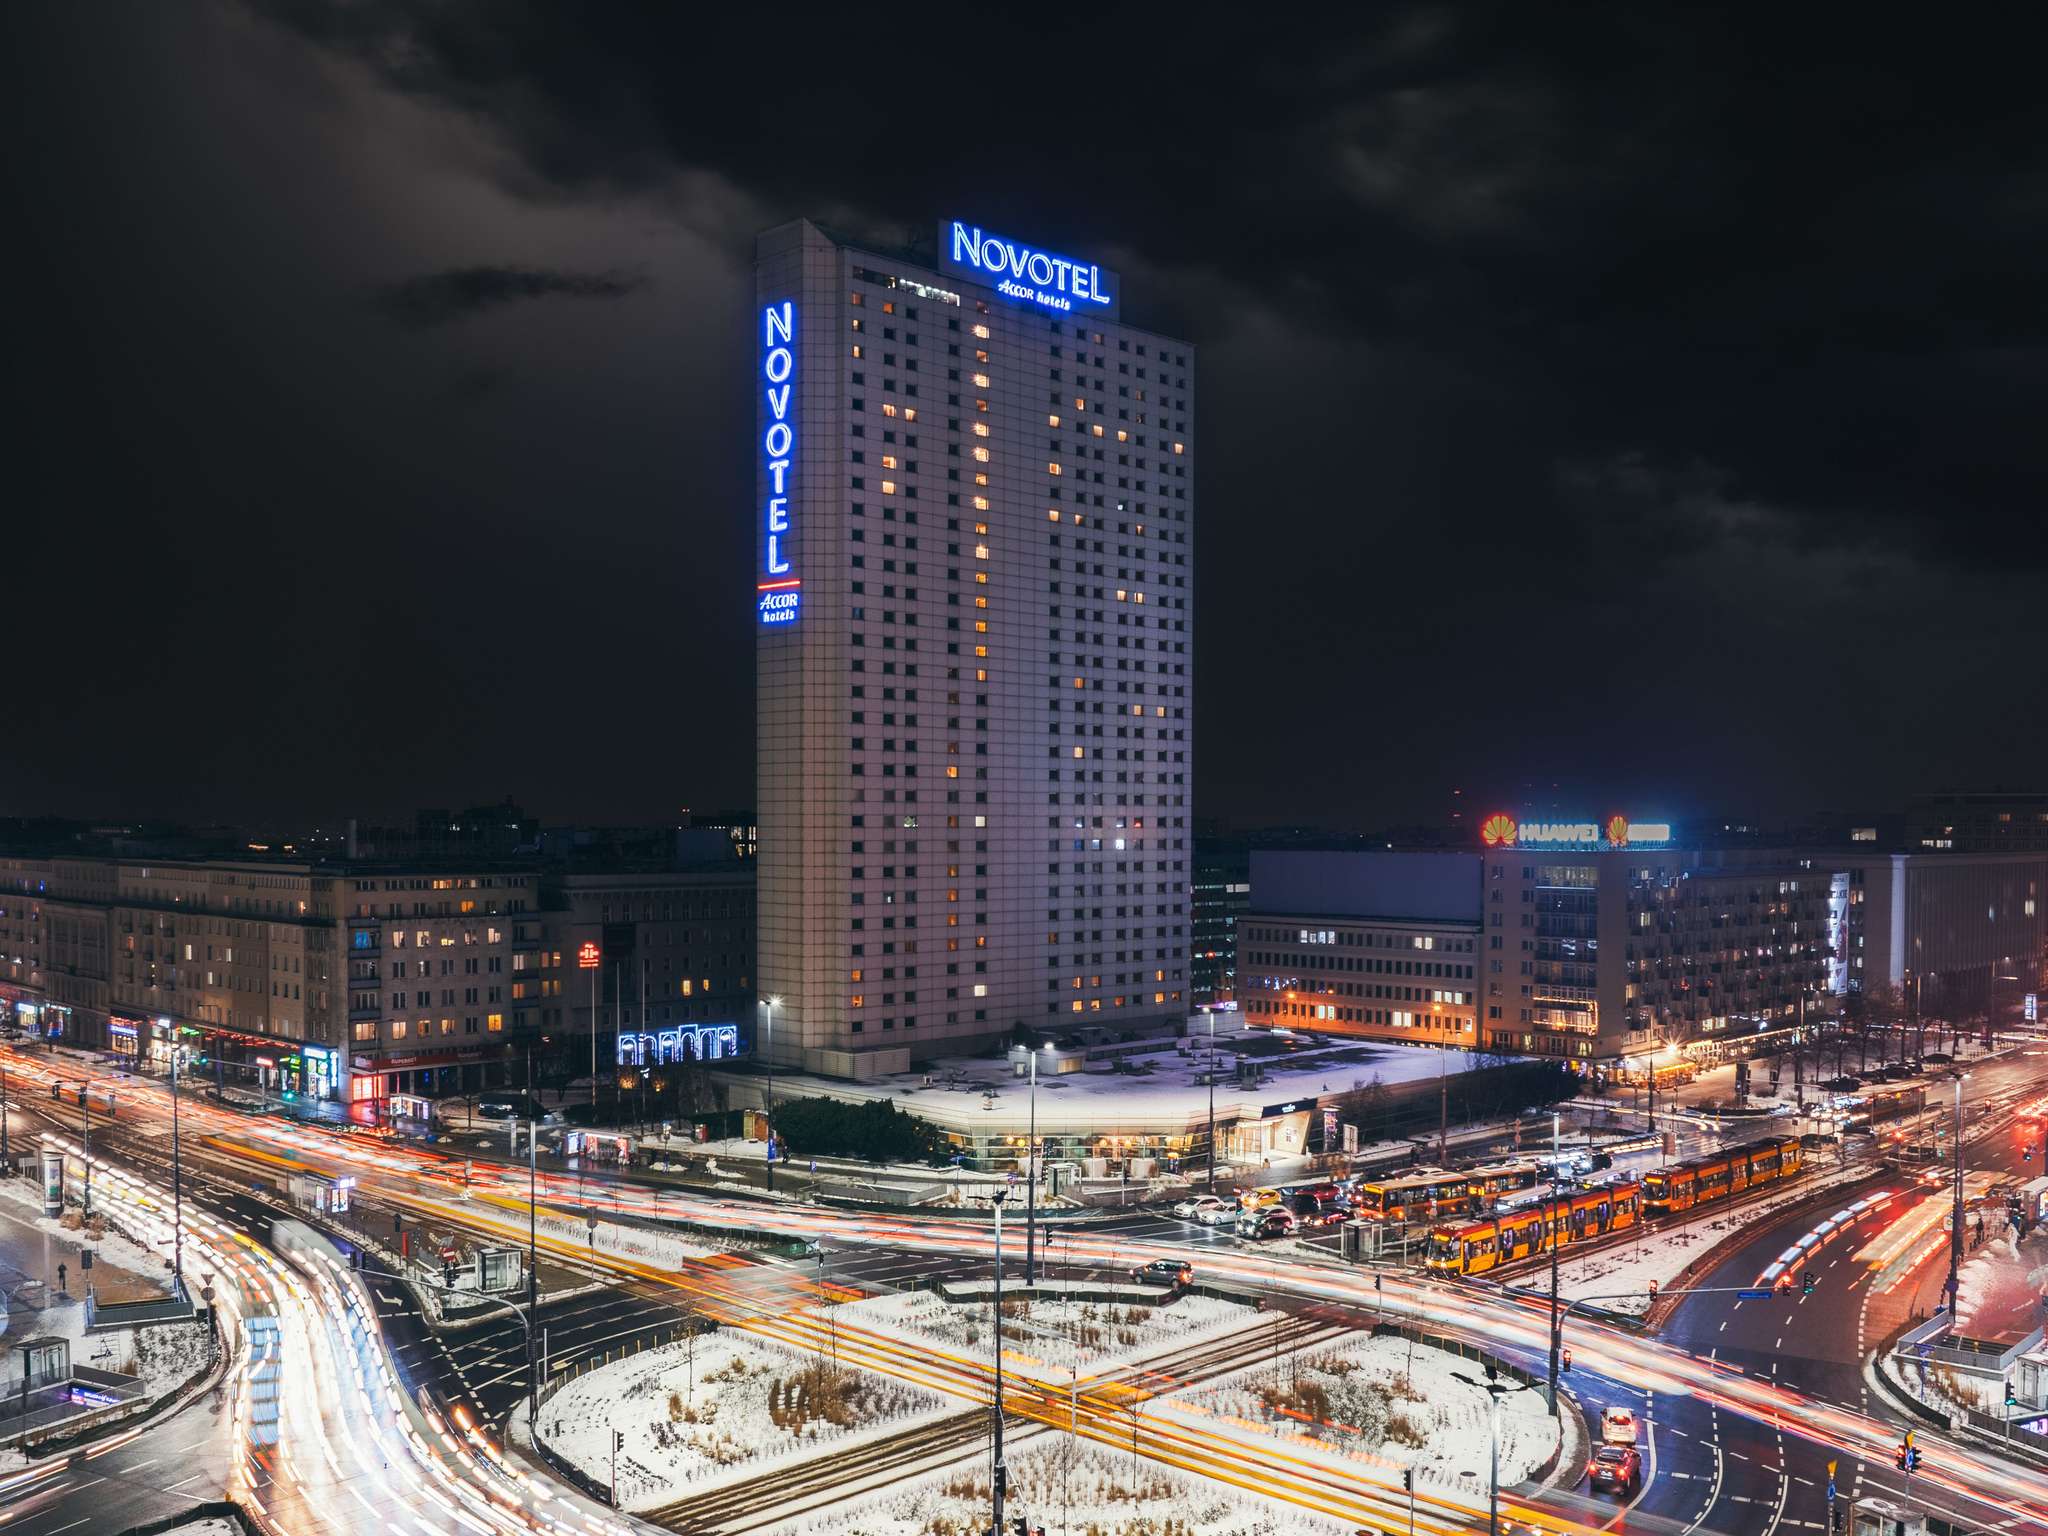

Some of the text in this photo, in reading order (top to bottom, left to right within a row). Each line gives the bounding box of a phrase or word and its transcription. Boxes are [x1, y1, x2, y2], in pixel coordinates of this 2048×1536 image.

[953, 221, 1111, 304] NOVOTEL
[998, 279, 1071, 311] ACCOR hotels
[766, 302, 792, 573] NOVOTEL
[760, 593, 798, 610] ACCOR
[763, 608, 795, 622] hotels
[1519, 823, 1598, 841] HUAWEI
